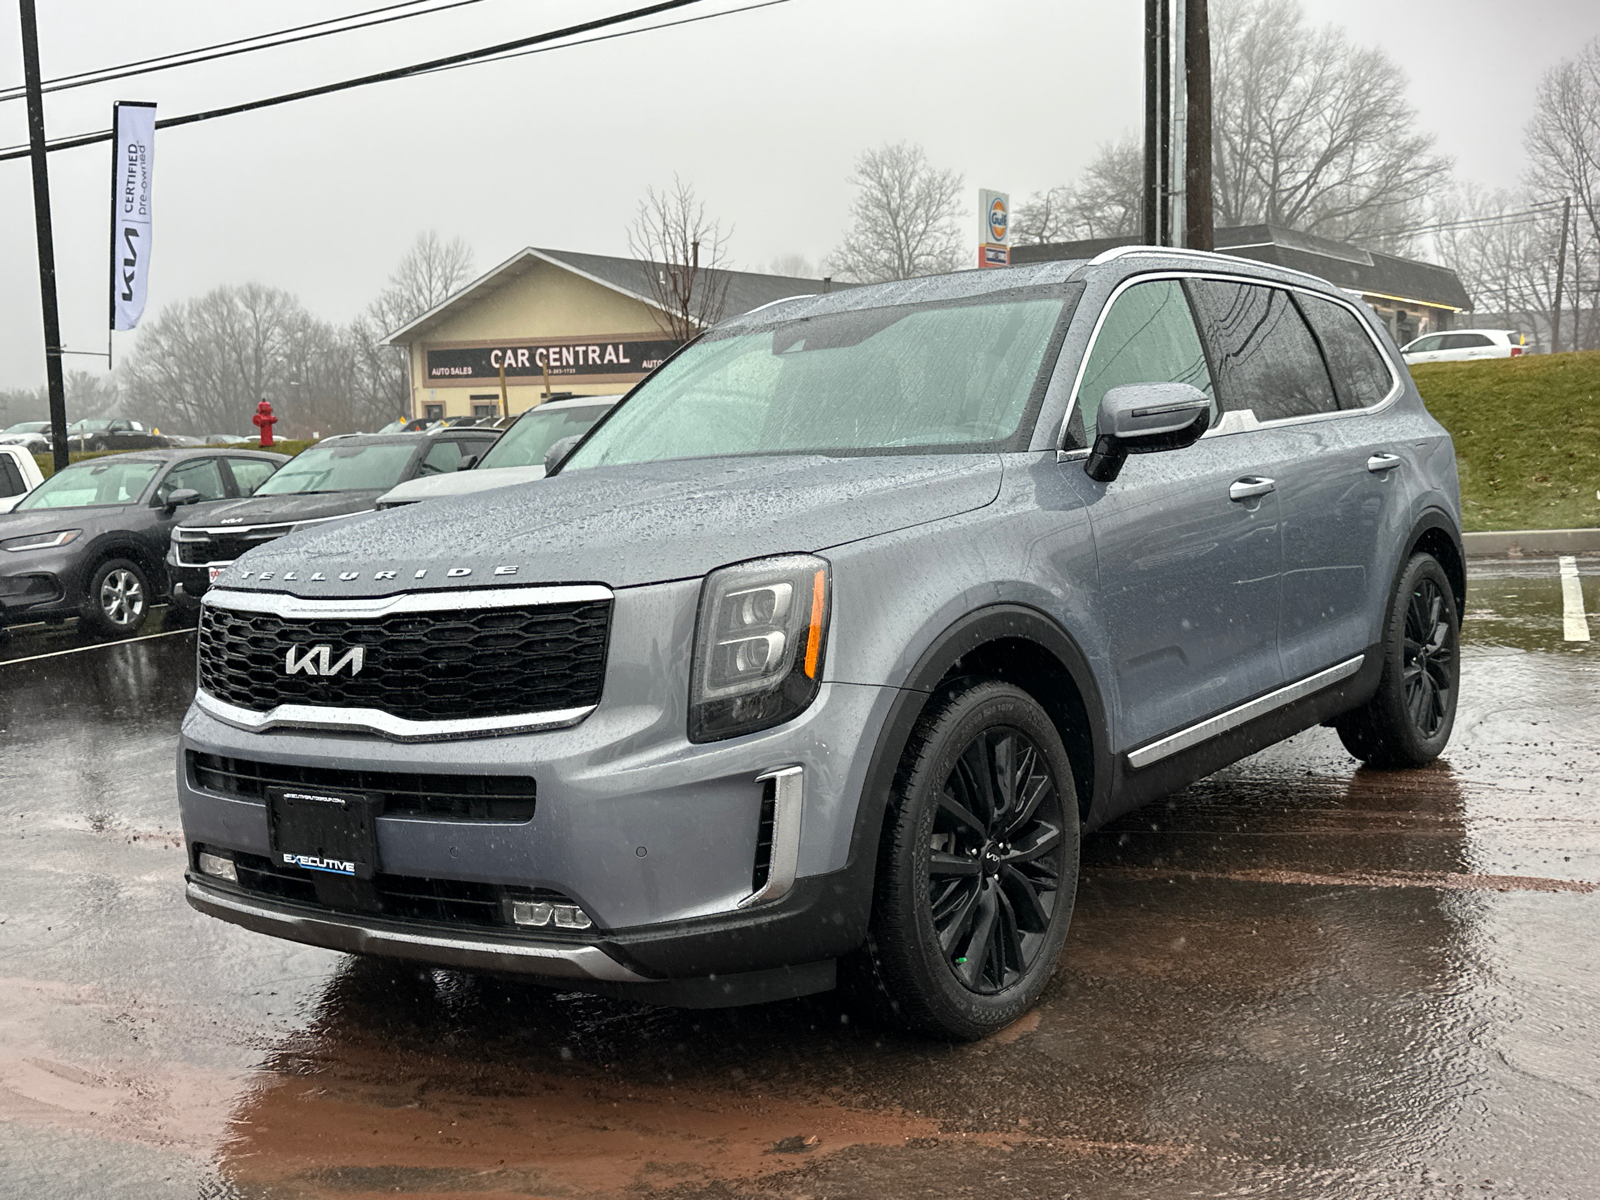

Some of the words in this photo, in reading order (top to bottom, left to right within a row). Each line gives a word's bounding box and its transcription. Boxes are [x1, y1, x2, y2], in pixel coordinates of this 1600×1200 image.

[124, 143, 138, 213] CERTIFIED
[138, 145, 148, 216] pre-owned
[991, 212, 1007, 226] Gulf
[121, 227, 140, 302] KIA
[490, 349, 530, 369] CAR
[535, 344, 631, 367] CENTRAL
[431, 367, 450, 376] AUTO
[450, 366, 472, 375] SALES
[241, 565, 519, 581] TELLURIDE
[285, 644, 364, 676] KIA
[283, 853, 355, 873] EXECUTIVE
